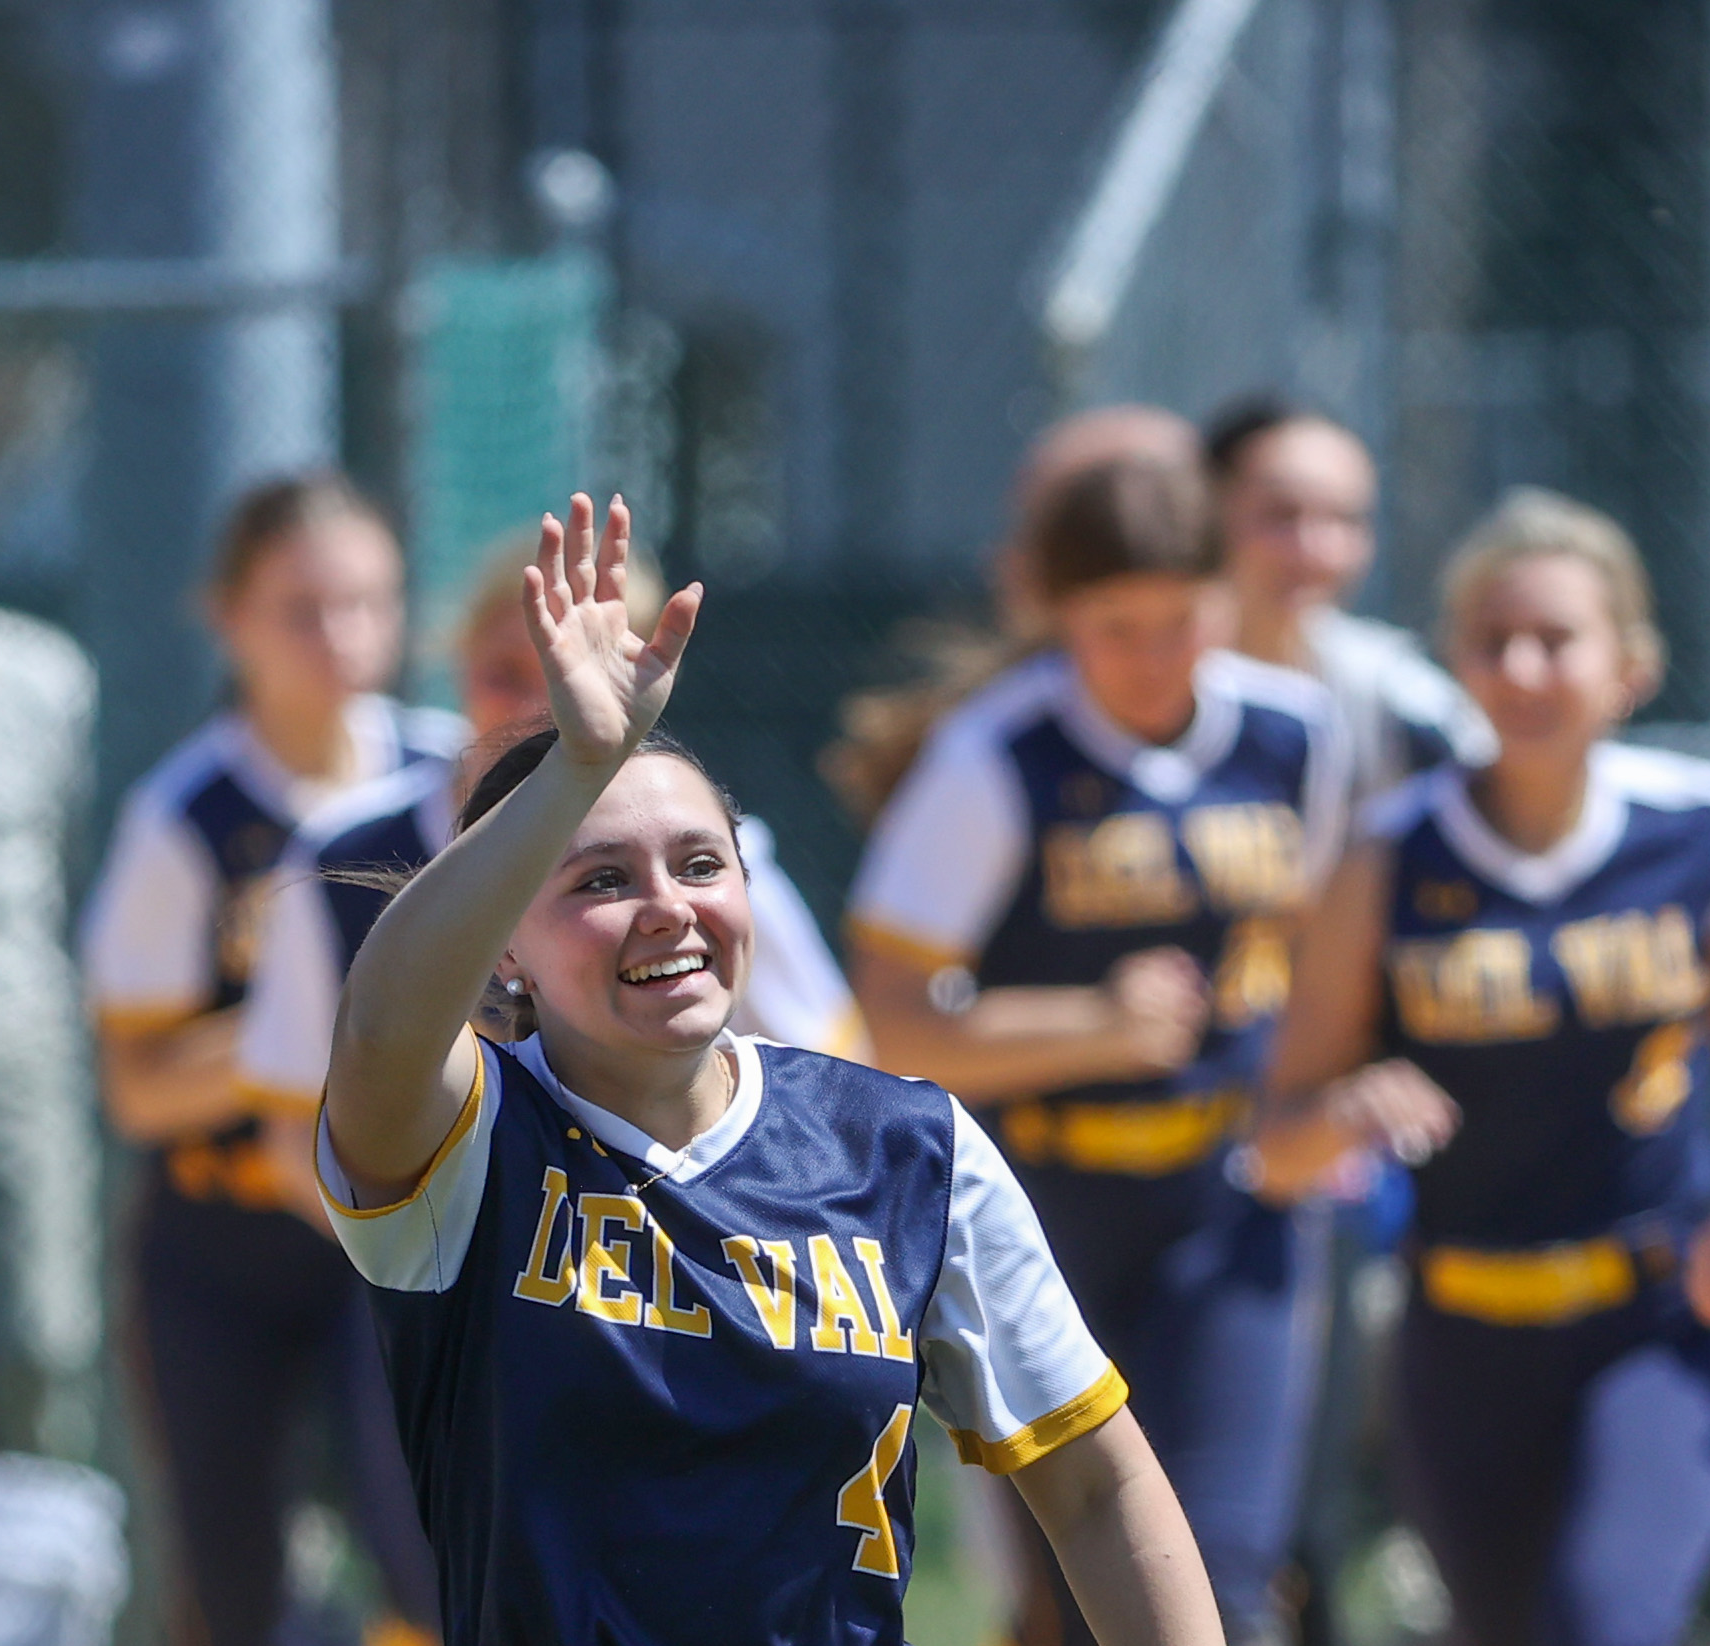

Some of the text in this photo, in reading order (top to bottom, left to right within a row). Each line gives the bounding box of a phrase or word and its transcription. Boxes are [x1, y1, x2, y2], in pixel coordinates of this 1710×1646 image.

[512, 1165, 915, 1364] DEL VAL
[836, 1402, 913, 1580] 4
